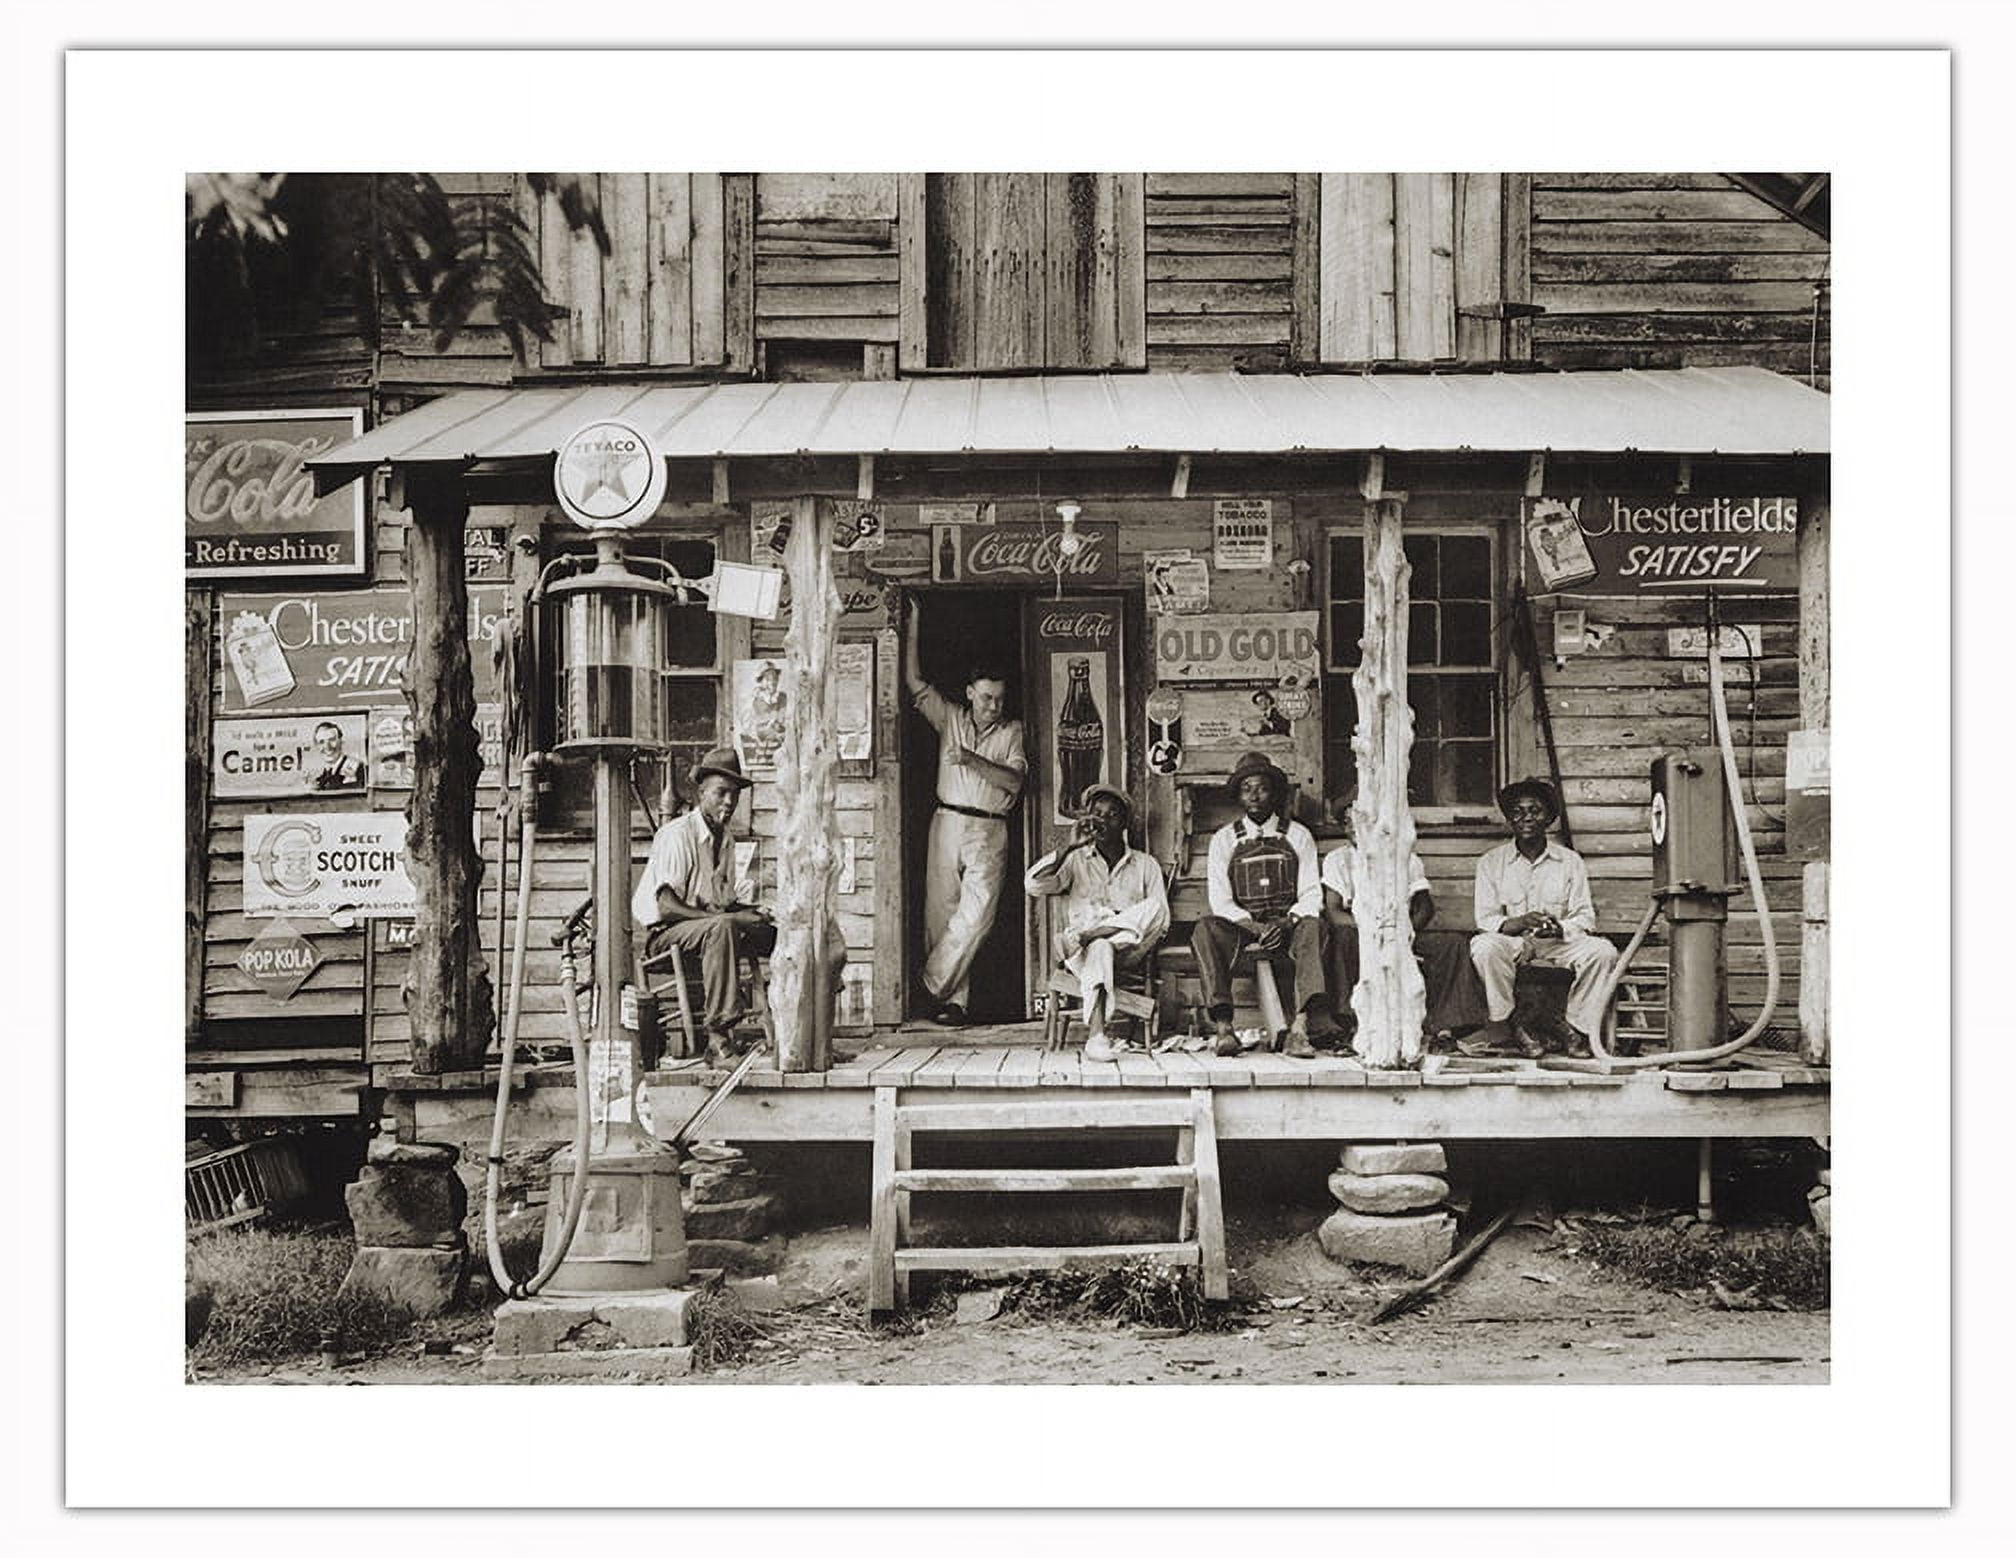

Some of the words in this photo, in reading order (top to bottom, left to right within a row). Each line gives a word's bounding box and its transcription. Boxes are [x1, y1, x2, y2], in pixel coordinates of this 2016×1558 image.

[575, 440, 636, 455] TEXACO
[187, 435, 333, 523] Cola
[1218, 510, 1267, 520] TOBACCO
[1569, 497, 1798, 537] Chesterfields
[1619, 545, 1762, 577] SATISFY
[268, 599, 498, 650] Chesters
[1159, 629, 1224, 663] OLD
[1228, 627, 1316, 662] GOLD
[319, 655, 404, 687] SATI
[339, 834, 383, 845] SWEET
[317, 851, 396, 872] SCOTCH
[341, 878, 383, 889] SNUFF
[244, 950, 273, 972] POP
[275, 948, 314, 969] KOLA
